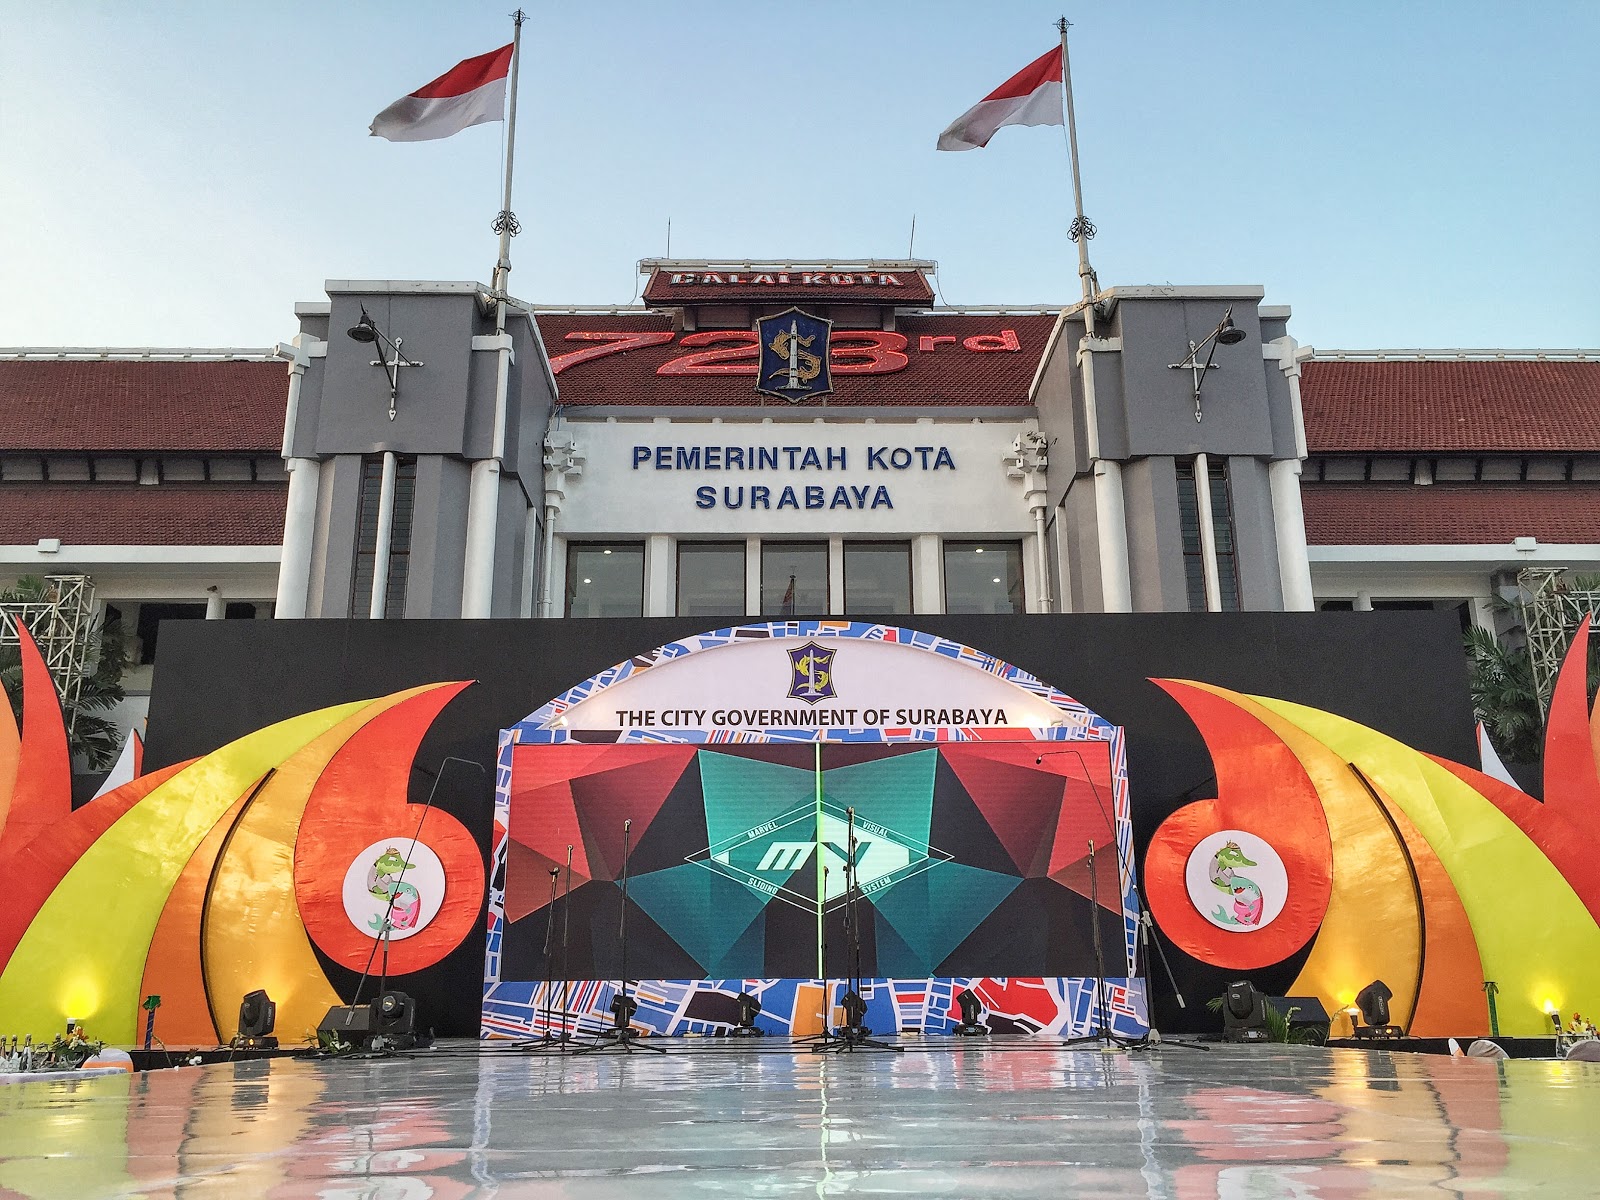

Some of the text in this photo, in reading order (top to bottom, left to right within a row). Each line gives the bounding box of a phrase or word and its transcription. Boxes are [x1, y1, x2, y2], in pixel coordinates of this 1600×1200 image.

[802, 272, 904, 286] KOTA
[633, 446, 956, 471] PEMERINTAH KOTA
[696, 485, 894, 510] SURABAYA
[616, 708, 1008, 726] THE CITY GOVERNMENT OF SURABAYA
[747, 821, 778, 839] MARVEL
[862, 821, 888, 838] VISUAL
[747, 877, 778, 895] SLIDING
[861, 876, 892, 894] SYSTEM
